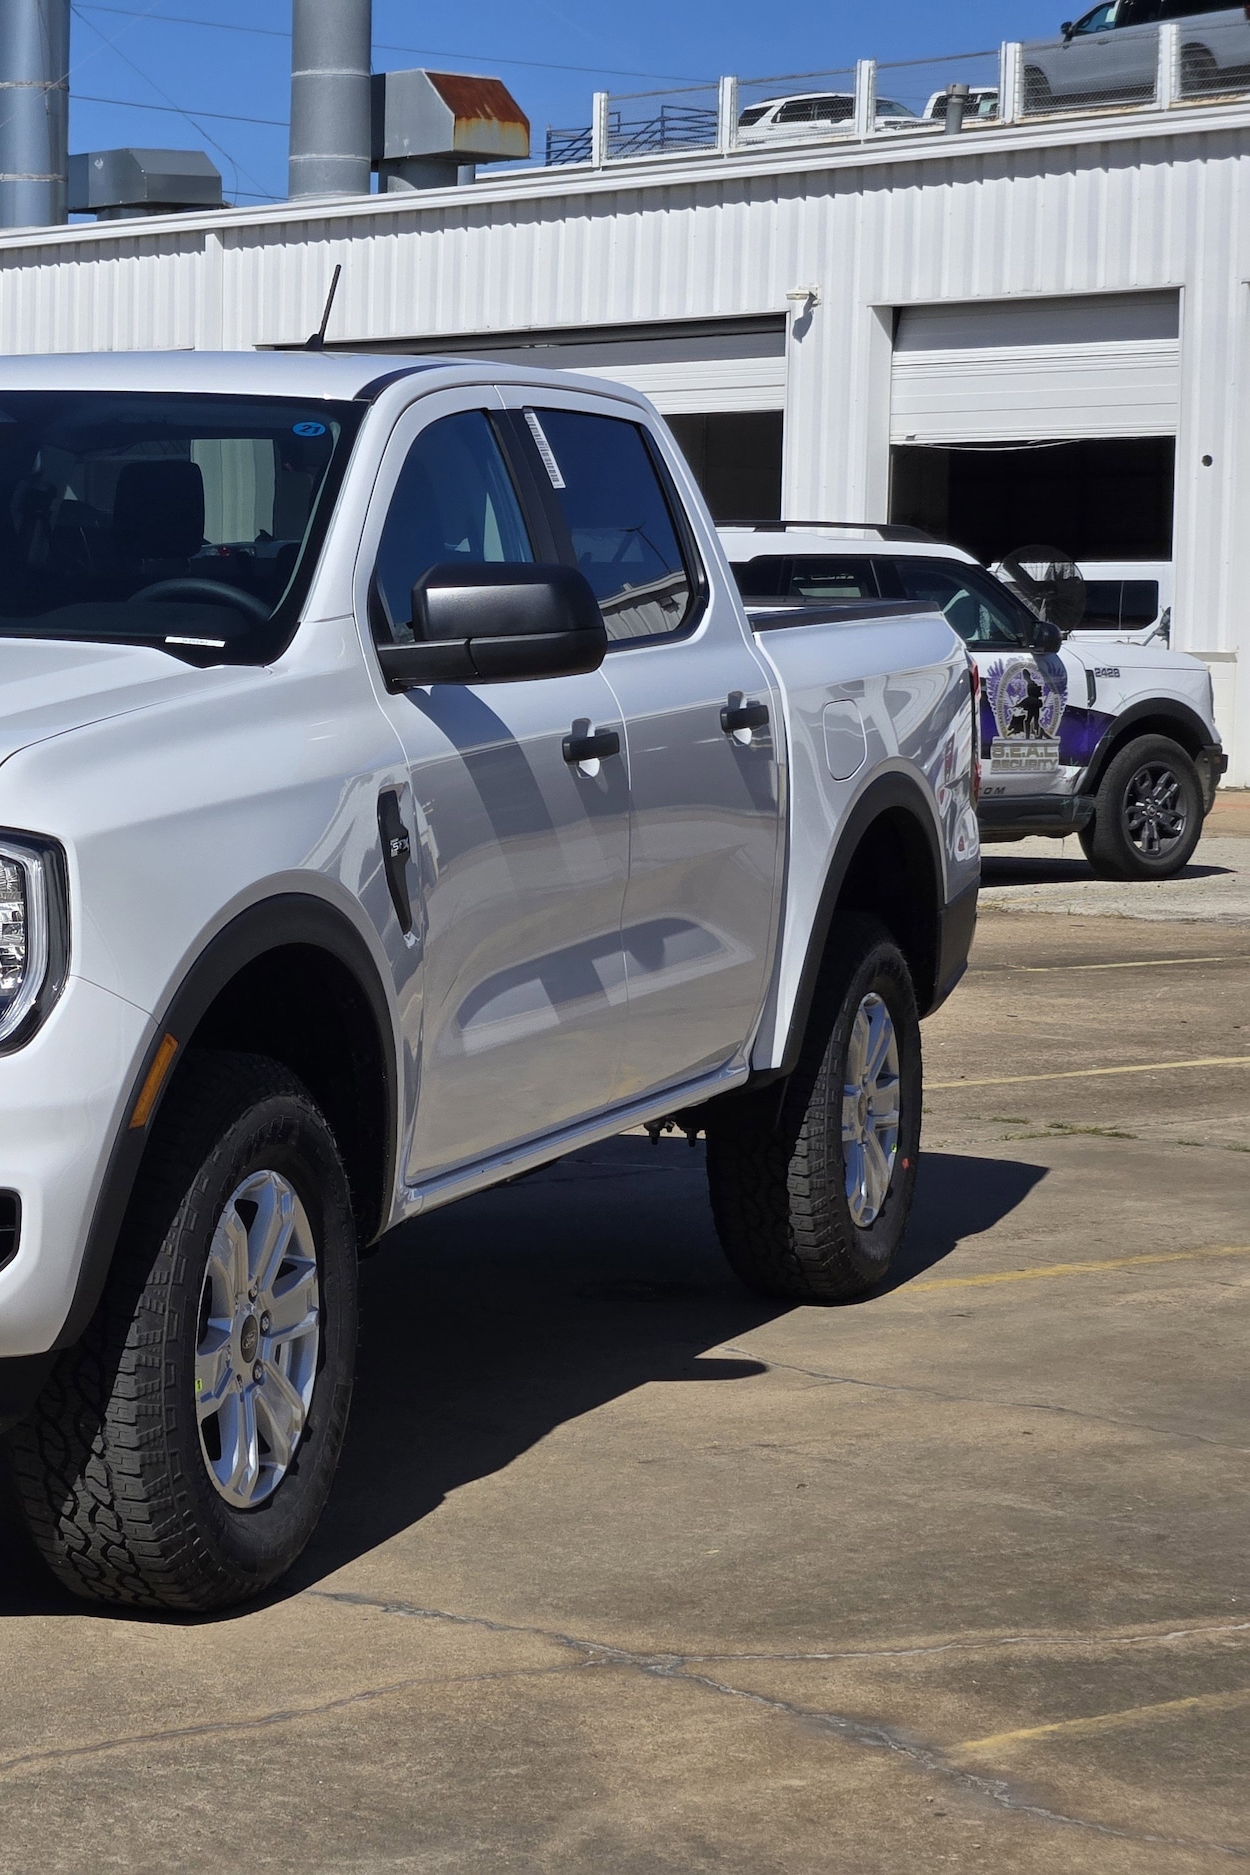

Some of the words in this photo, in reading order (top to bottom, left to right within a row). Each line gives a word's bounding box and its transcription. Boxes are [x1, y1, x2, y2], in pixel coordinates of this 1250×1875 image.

[1094, 667, 1120, 678] 2428
[991, 758, 1058, 771] SECURITY
[979, 786, 1006, 795] OM
